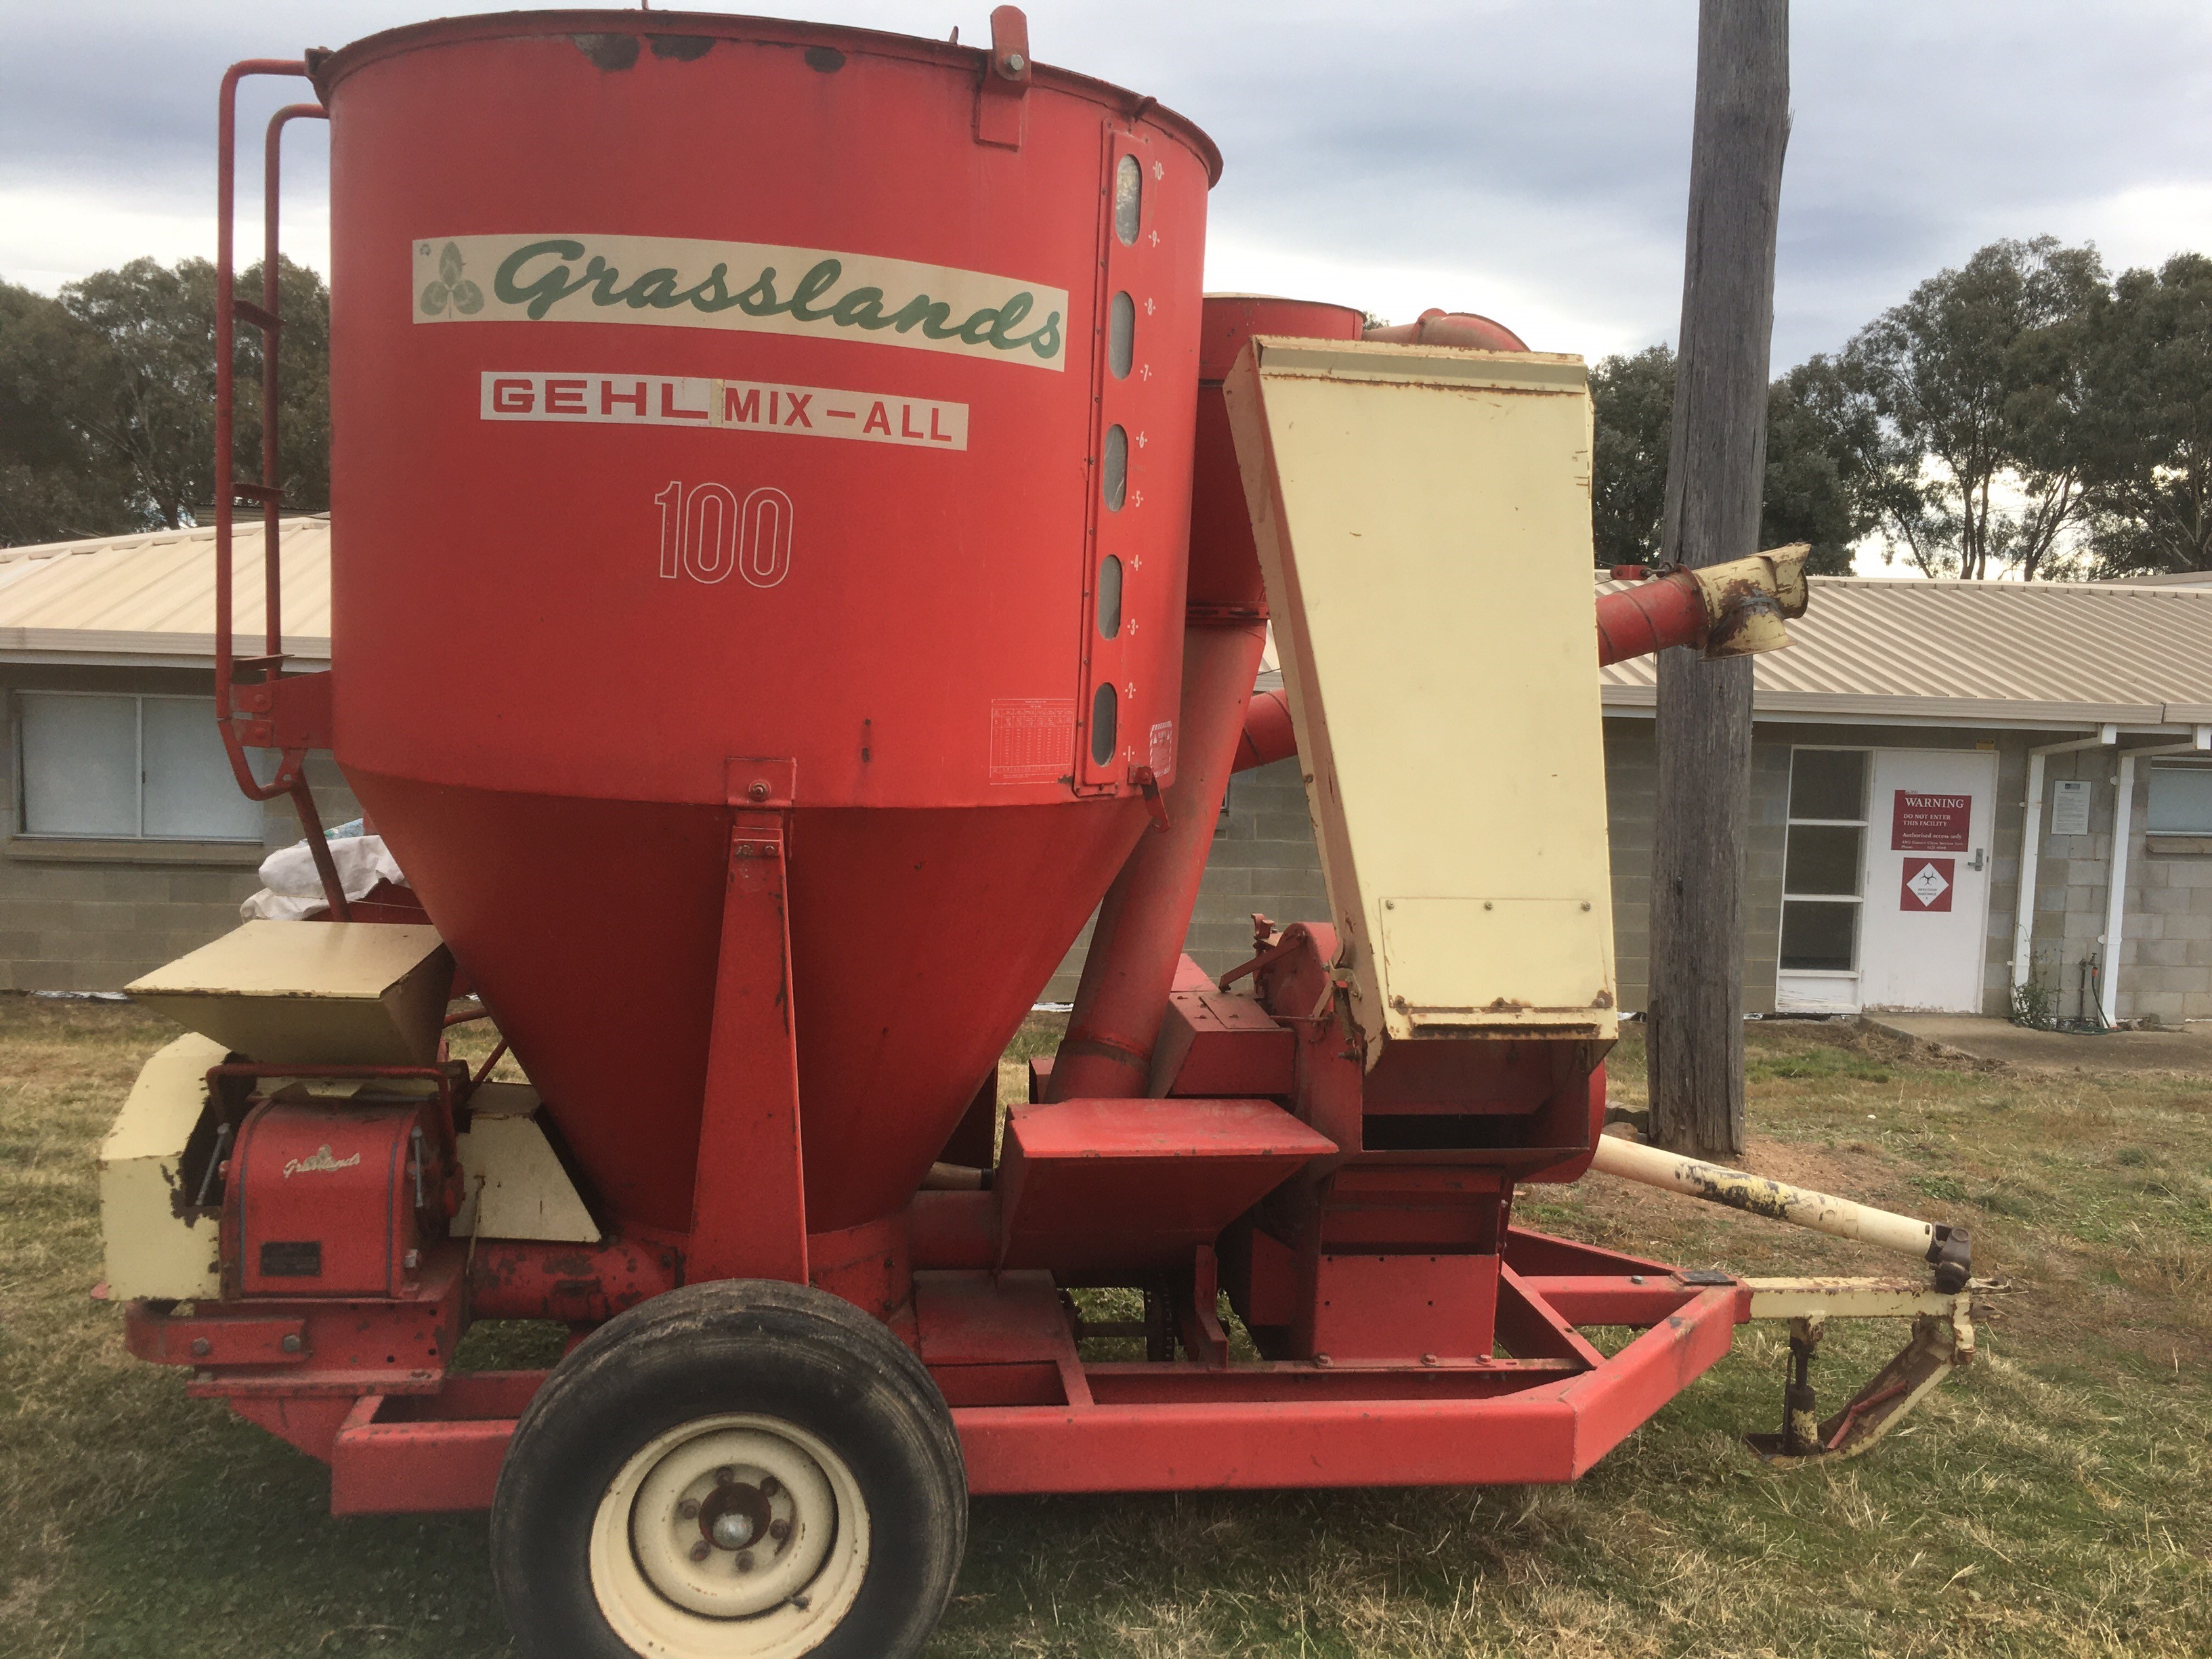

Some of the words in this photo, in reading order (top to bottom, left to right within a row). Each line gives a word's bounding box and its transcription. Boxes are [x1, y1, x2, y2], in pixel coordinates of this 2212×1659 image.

[493, 239, 1061, 359] Grasslands
[493, 379, 708, 419] GEHL
[654, 481, 794, 588] 100
[1905, 798, 1964, 809] WARNING
